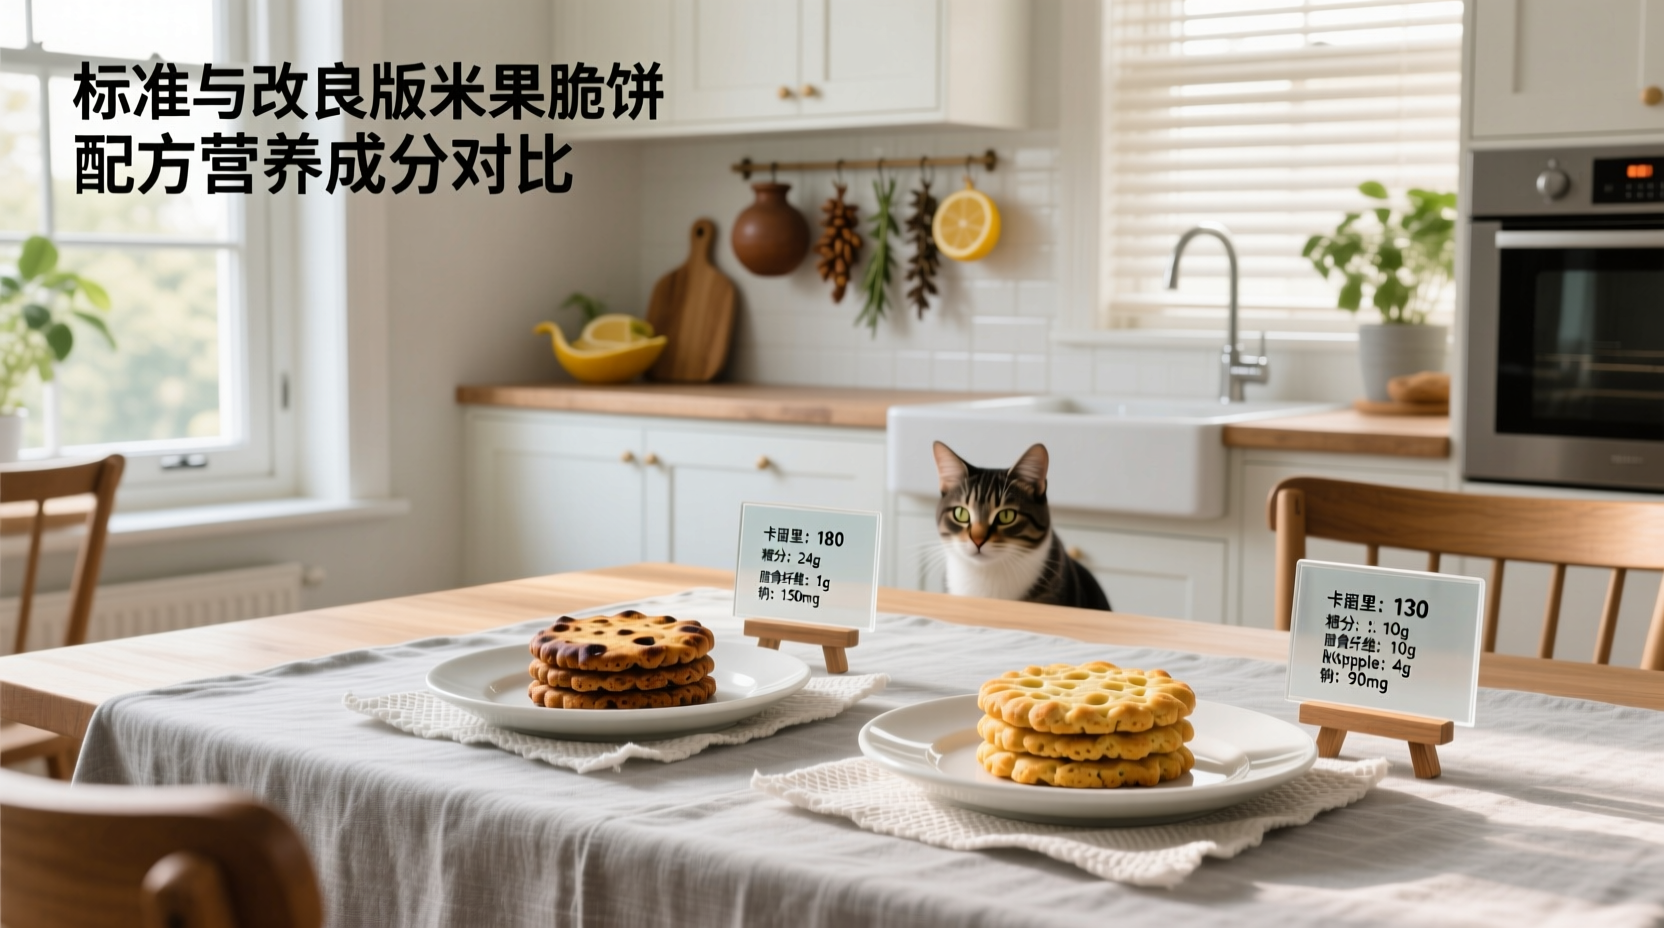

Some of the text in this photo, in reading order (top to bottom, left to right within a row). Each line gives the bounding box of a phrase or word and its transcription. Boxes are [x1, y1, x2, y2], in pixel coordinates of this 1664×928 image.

[817, 531, 844, 547] 180
[798, 552, 821, 569] 24g
[817, 575, 831, 592] 1g
[781, 589, 820, 608] 150mg
[1394, 597, 1429, 619] 130
[1383, 622, 1410, 641] 10g
[1390, 641, 1417, 660] 10g
[1392, 659, 1411, 678] 4g
[1347, 672, 1389, 694] 90mg
